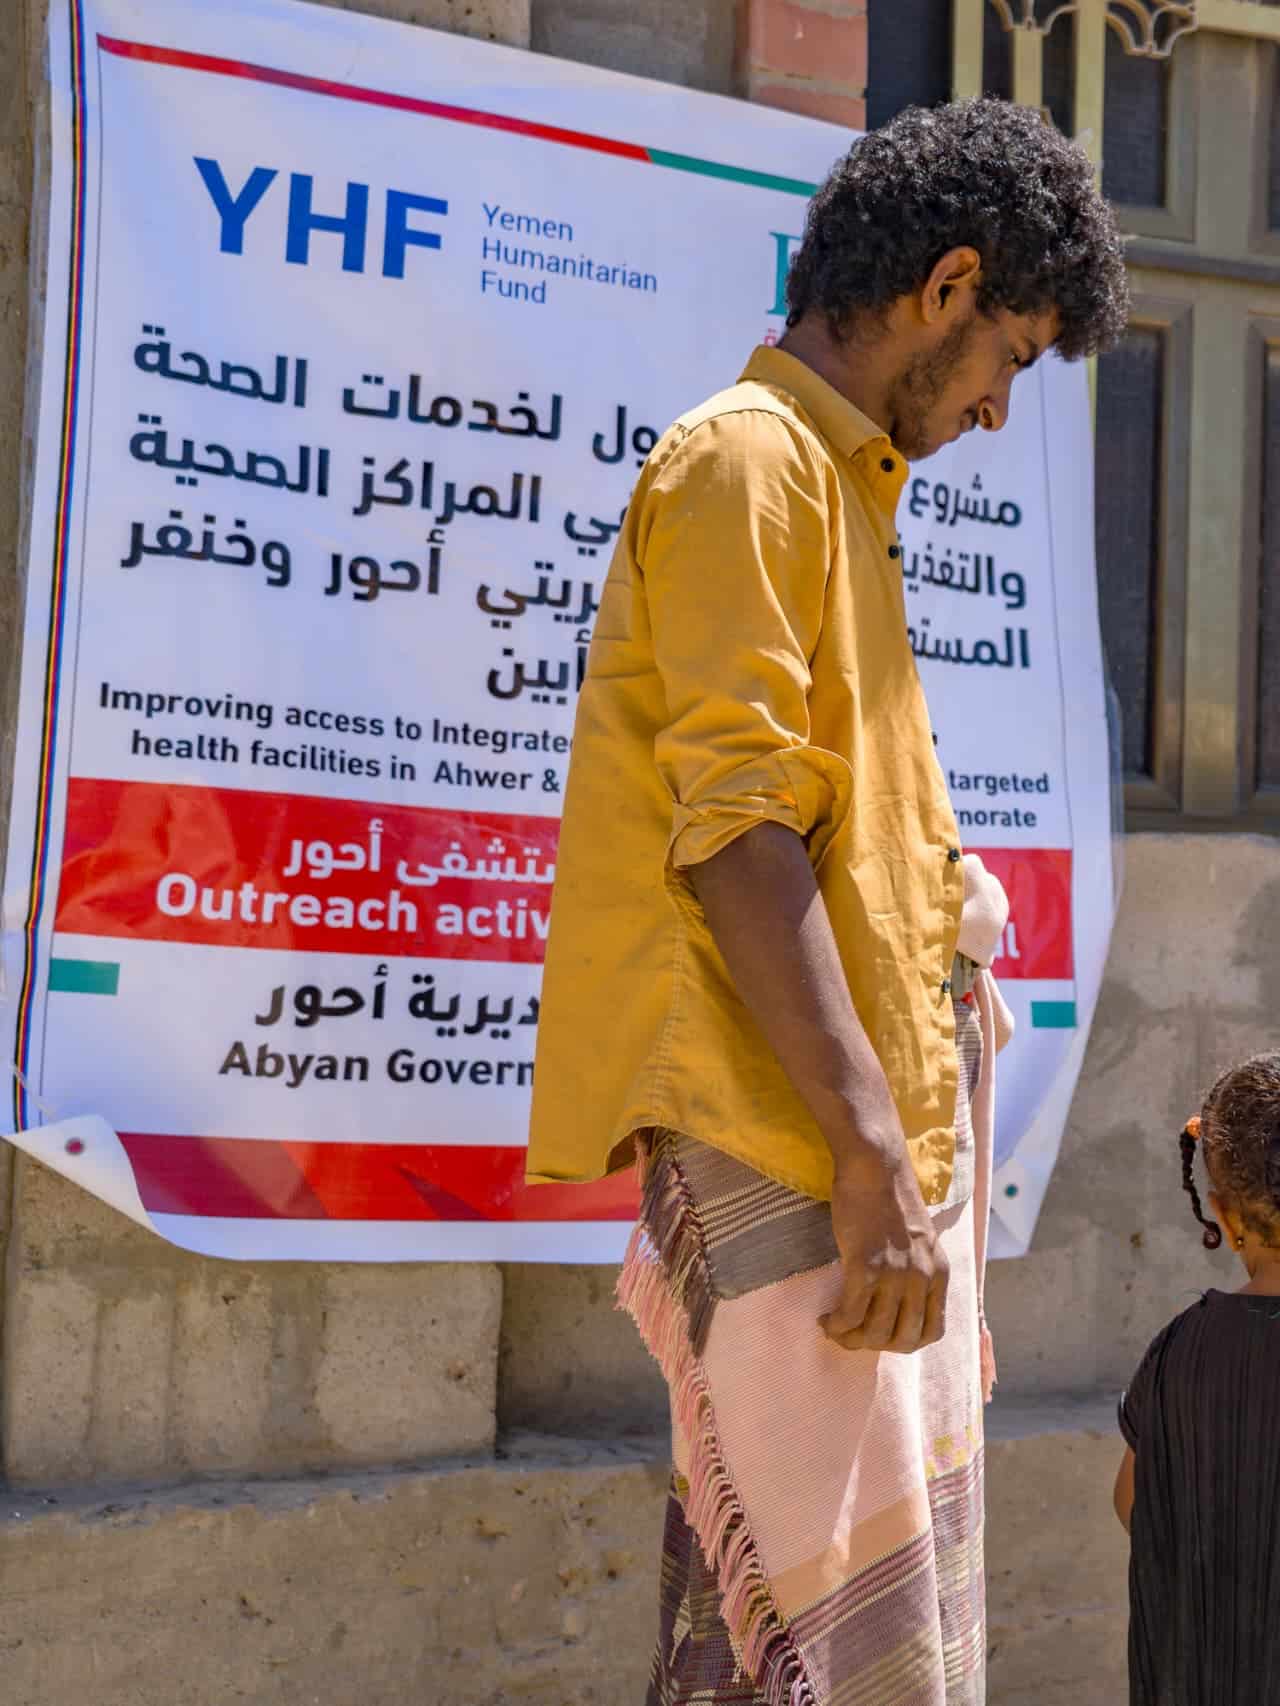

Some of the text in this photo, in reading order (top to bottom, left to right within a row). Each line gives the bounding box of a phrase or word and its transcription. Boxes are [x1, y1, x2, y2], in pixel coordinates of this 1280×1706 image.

[193, 156, 449, 280] YHF
[483, 202, 574, 242] Yemen
[480, 270, 547, 303] Fund
[482, 237, 658, 292] Humanitarian
[133, 323, 309, 408] الصحة
[343, 374, 563, 441] لخدمات
[128, 413, 331, 497] الصحية
[352, 456, 542, 525] المراكز
[909, 473, 1022, 527] مشروع
[120, 509, 292, 588] وخنفر
[323, 528, 446, 602] أحور
[476, 560, 600, 630] ريتي
[100, 682, 1050, 796] Improving access to Integrate targeted
[131, 728, 1038, 828] health facilities in Ahwer & norate
[282, 819, 384, 878] أحور
[156, 872, 551, 940] Outreach activ
[254, 963, 540, 1040] ديرية أحور
[218, 1041, 535, 1089] Abyan Govern
